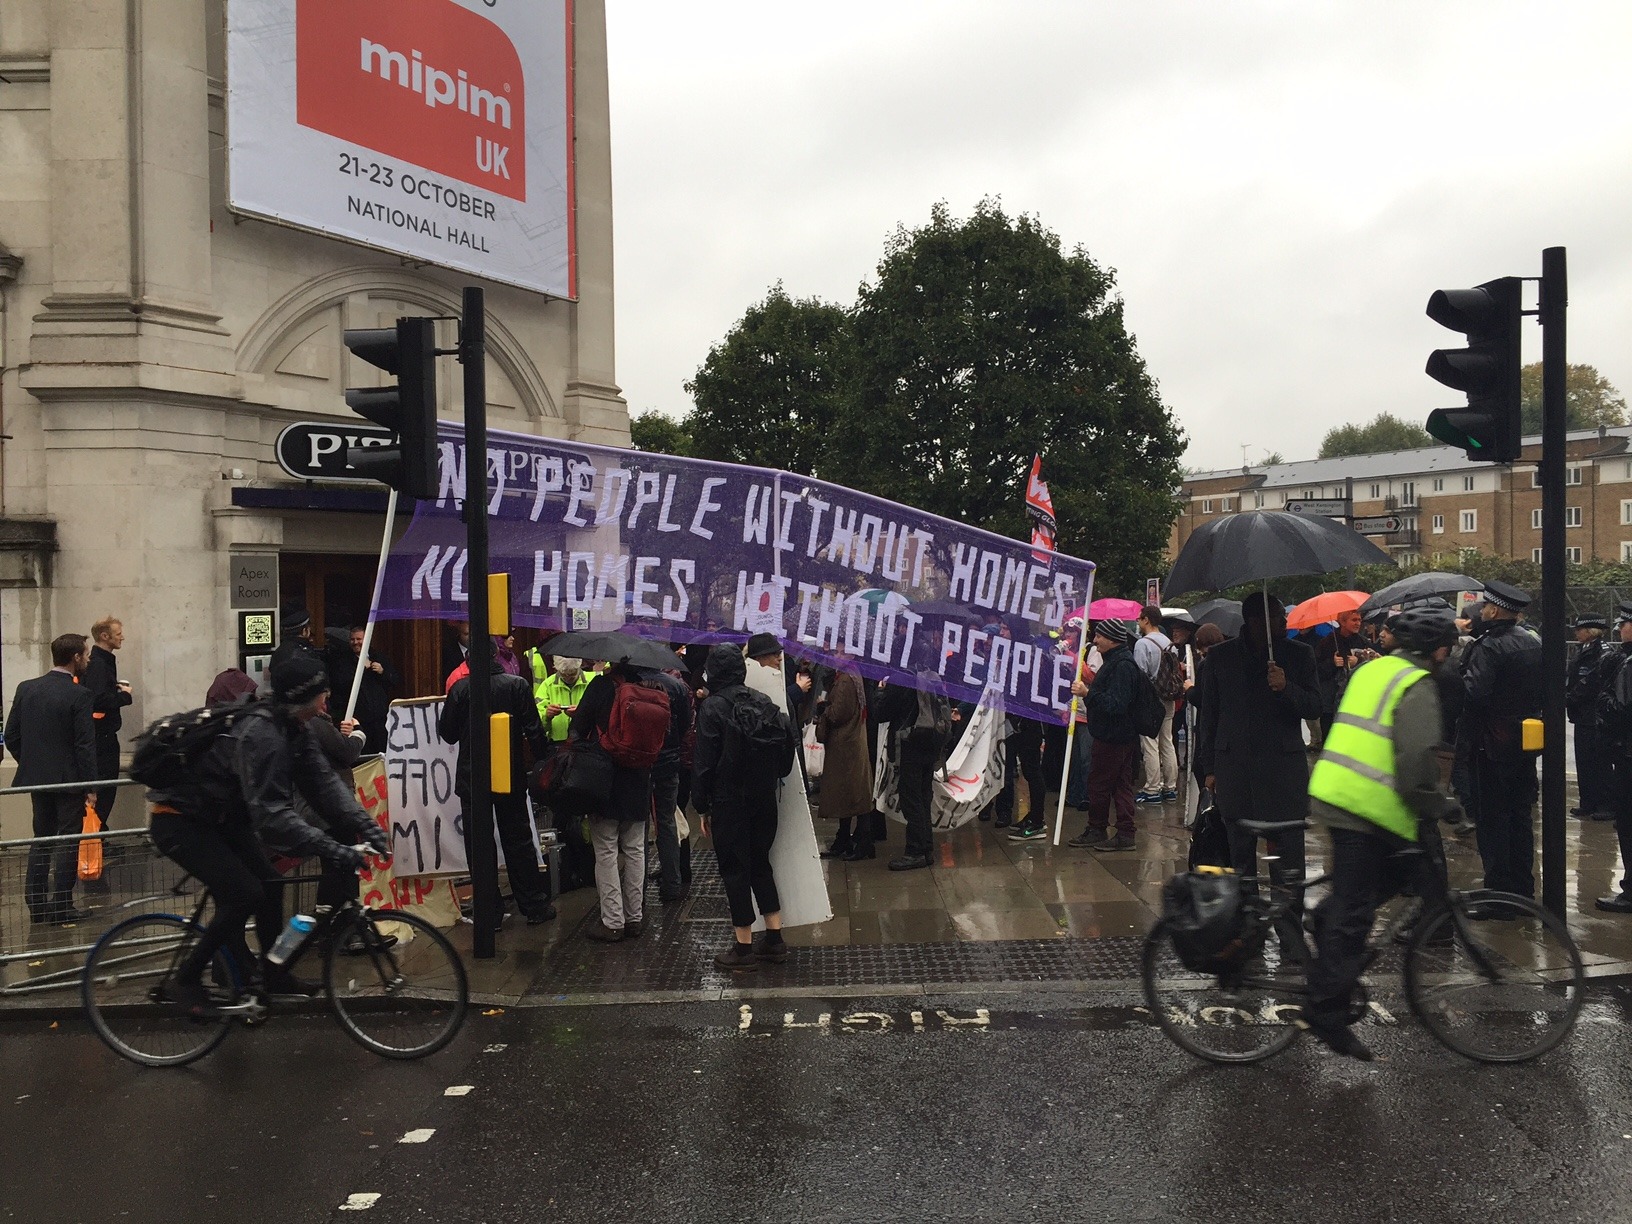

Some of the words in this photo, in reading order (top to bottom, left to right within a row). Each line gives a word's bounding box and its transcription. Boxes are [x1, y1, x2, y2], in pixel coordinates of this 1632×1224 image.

[360, 37, 511, 129] mipim
[338, 152, 394, 188] 21-23
[400, 174, 496, 222] OCTOBER
[475, 135, 511, 181] UK
[347, 194, 442, 239] NATIONAL
[447, 226, 490, 254] HALL
[239, 567, 270, 582] Apex
[529, 459, 727, 540] PEOPLE
[743, 484, 934, 588] WITHOUT
[950, 542, 1076, 628] HOMES
[238, 585, 270, 599] Room
[531, 549, 696, 622] HOMES
[733, 570, 923, 669] WITHOUT
[938, 621, 1075, 711] PEOPLE
